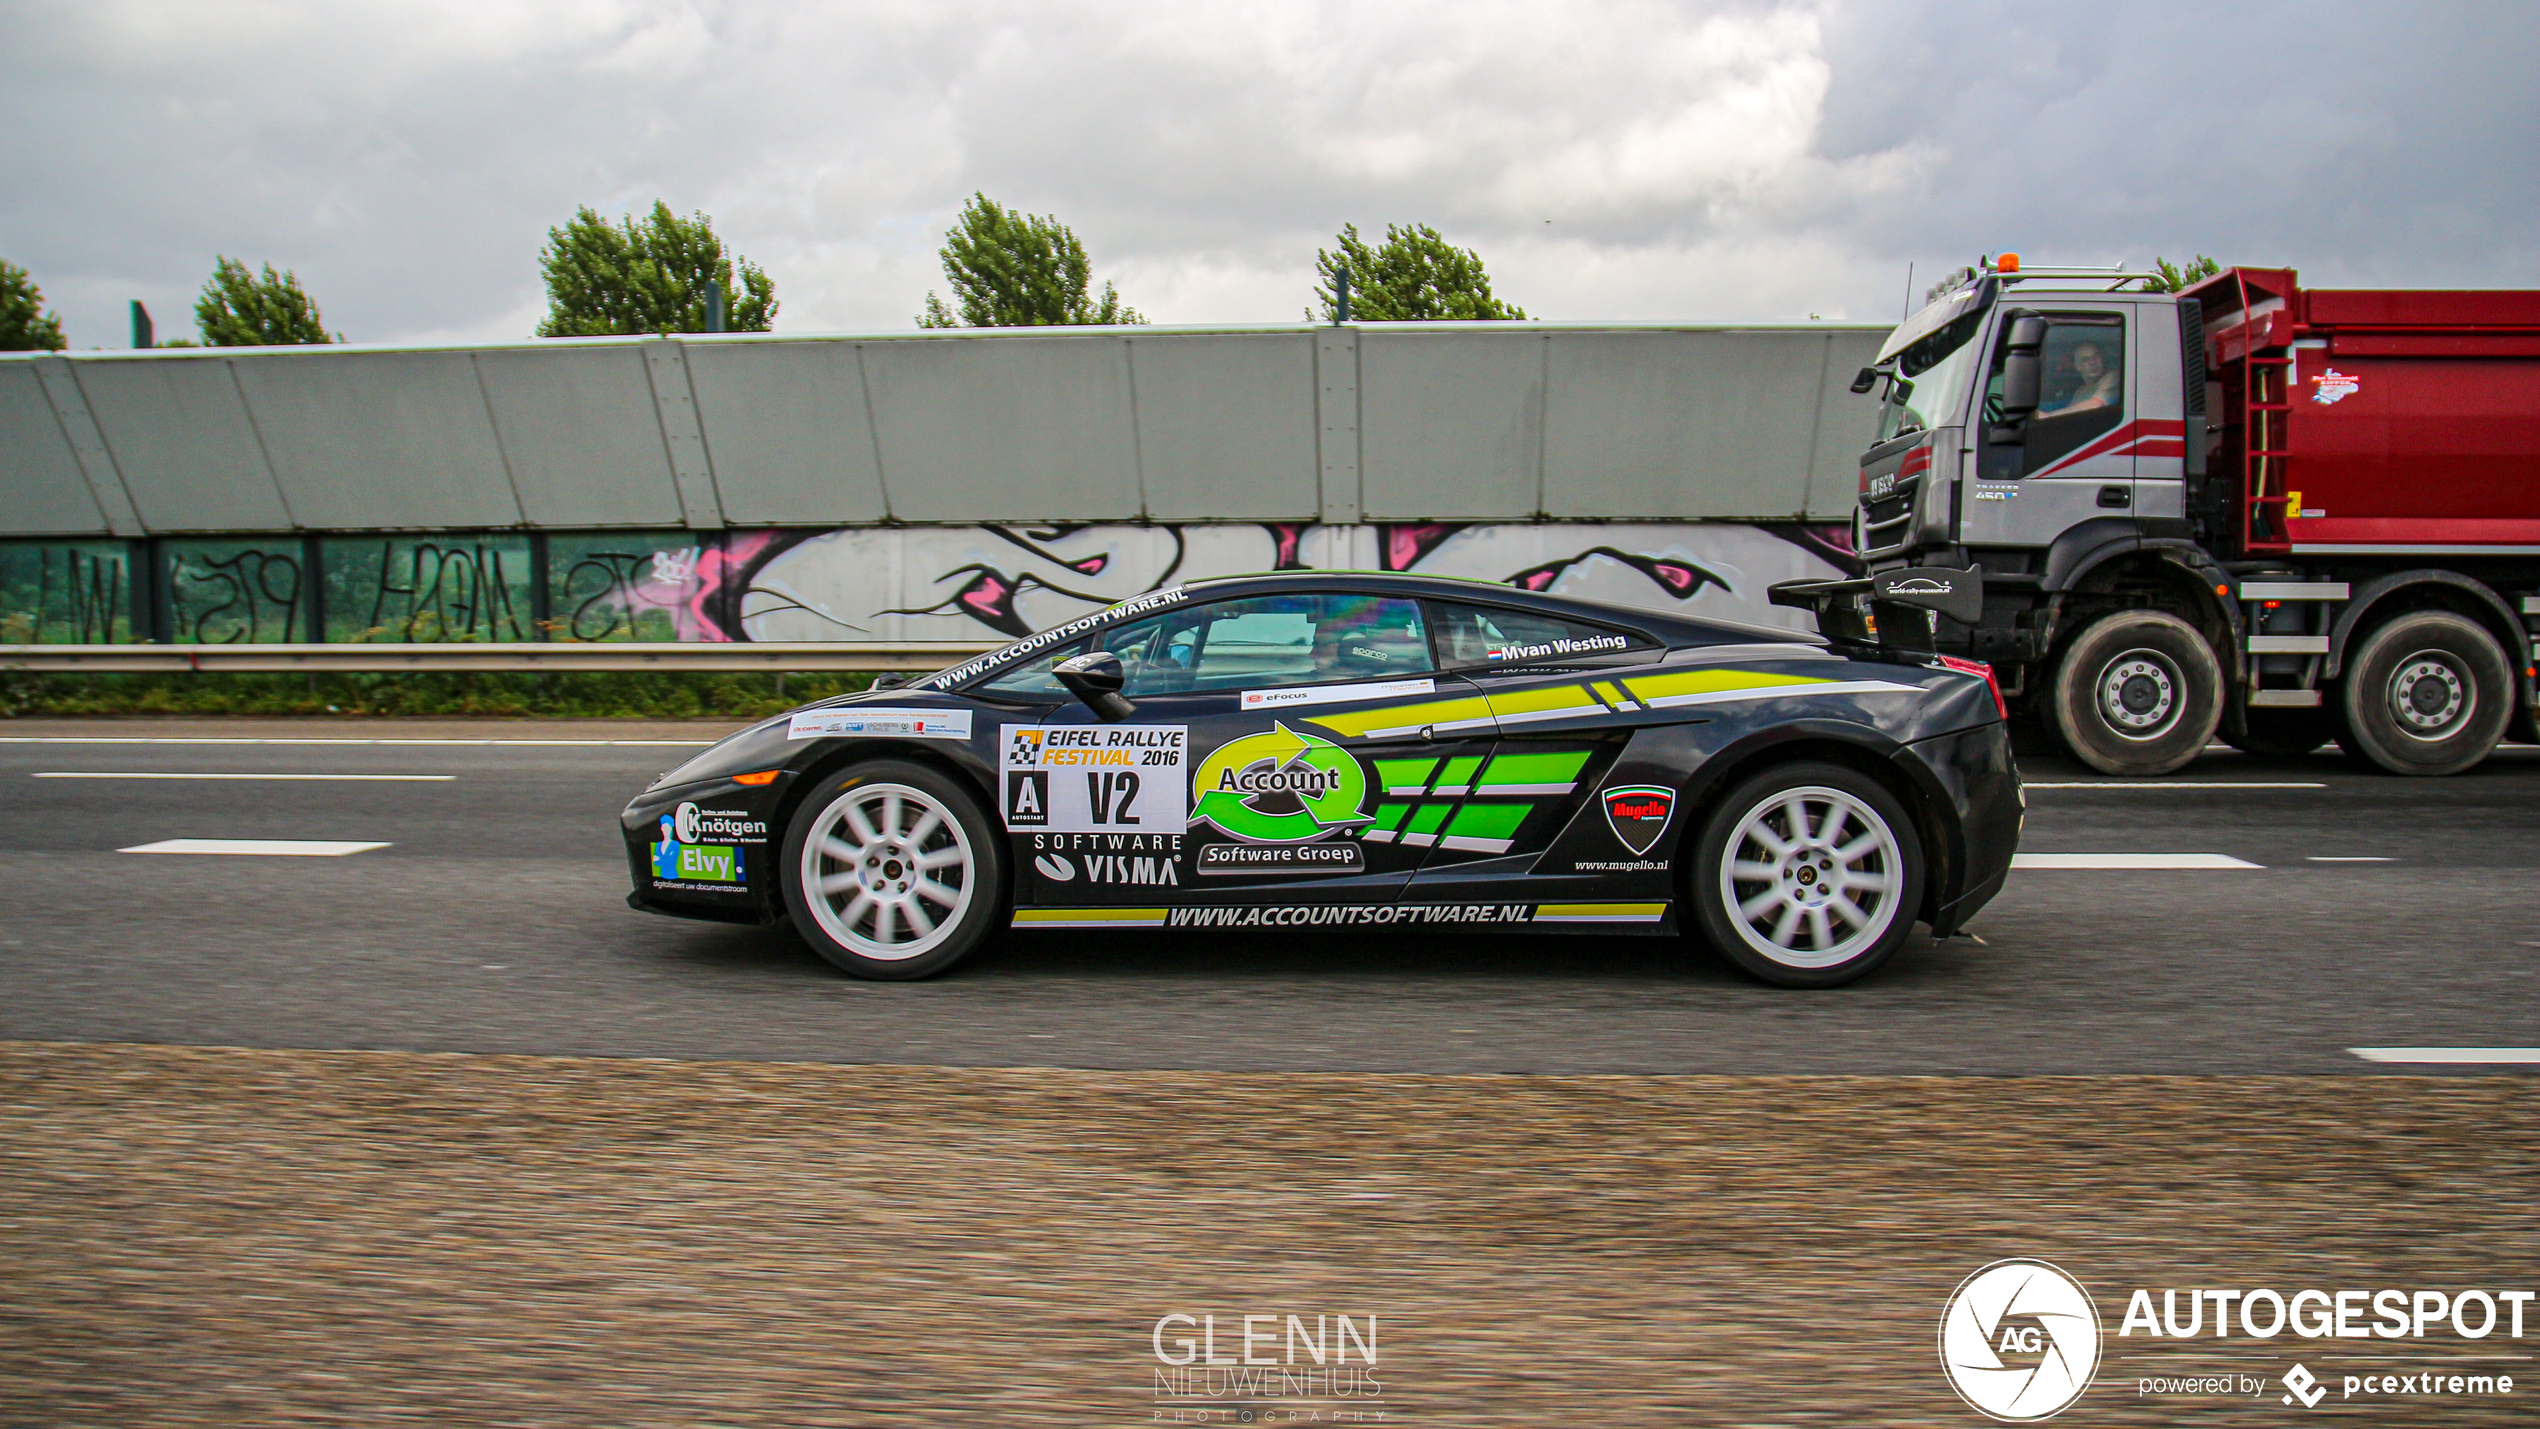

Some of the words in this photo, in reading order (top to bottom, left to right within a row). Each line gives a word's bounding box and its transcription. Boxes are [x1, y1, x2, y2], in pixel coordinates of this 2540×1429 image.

[1975, 492, 2005, 500] 450
[934, 590, 1189, 691] WWW.ACCOUNTSOFTWARE.NL
[1552, 634, 1627, 655] Westing
[1266, 692, 1308, 701] eFocus
[1047, 730, 1102, 746] EIFEL
[1107, 731, 1184, 747] RALLYE
[1041, 749, 1135, 766] FESTIVAL
[1140, 750, 1180, 766] 2016
[1217, 766, 1339, 792] Account
[1015, 776, 1041, 813] A
[1086, 771, 1141, 825] V2
[1613, 801, 1666, 820] Mugello
[688, 813, 767, 837] Knötgen
[1034, 834, 1182, 850] SOFTWARE
[1207, 846, 1293, 863] Software
[1296, 845, 1355, 863] Groep
[1574, 860, 1669, 872] www.mugello.nl
[1169, 905, 1530, 927] WWW.ACCOUNTSOFTWARE.NL
